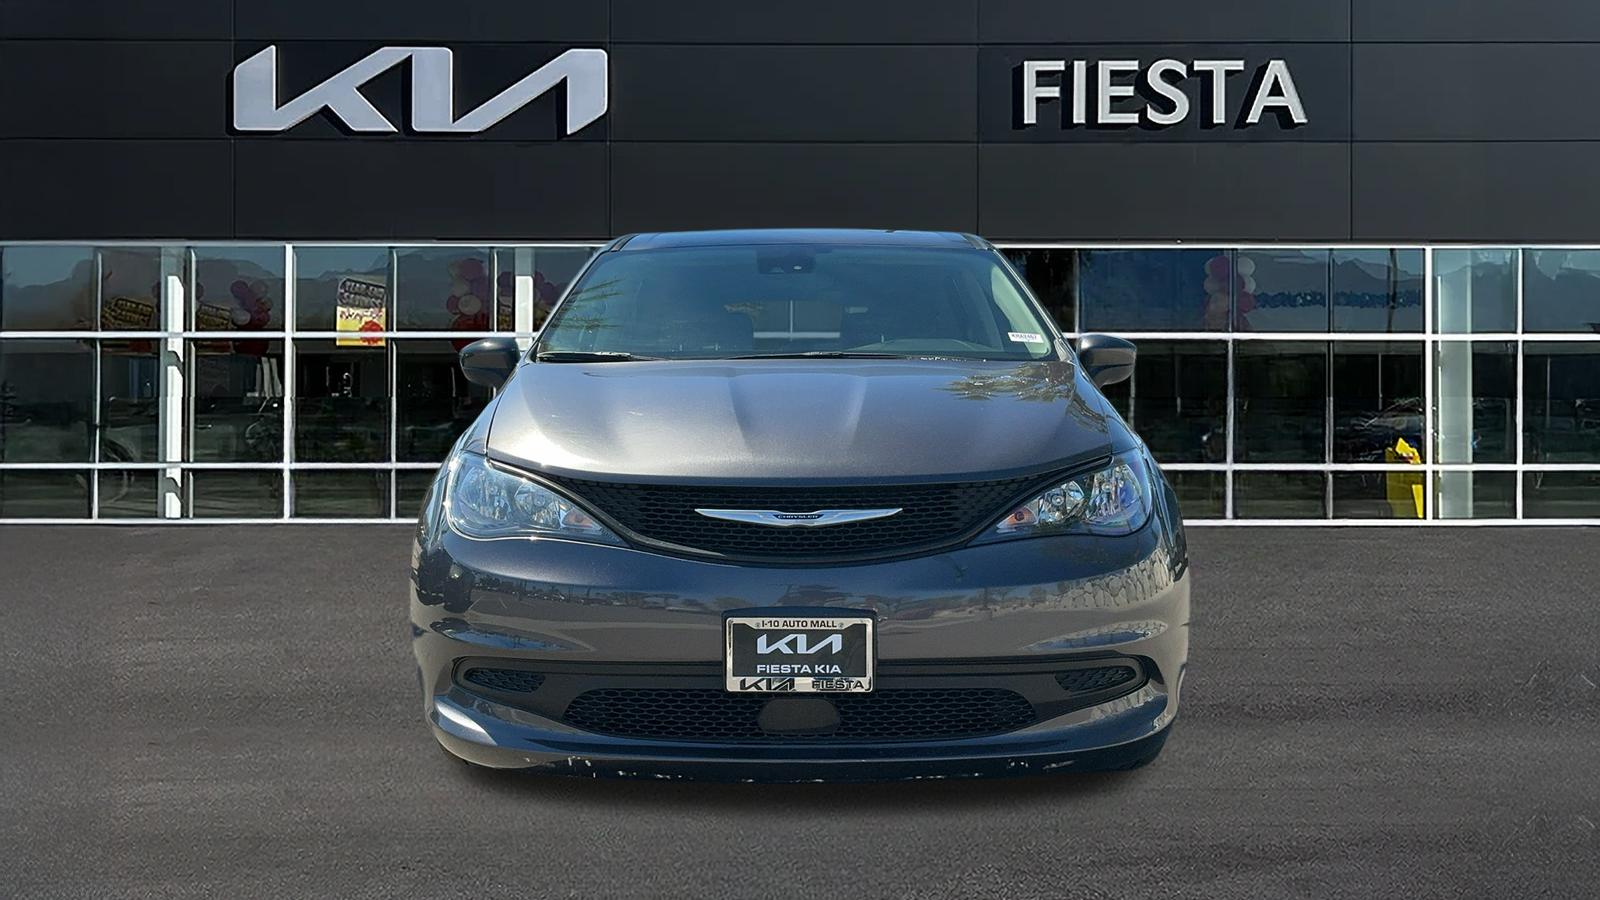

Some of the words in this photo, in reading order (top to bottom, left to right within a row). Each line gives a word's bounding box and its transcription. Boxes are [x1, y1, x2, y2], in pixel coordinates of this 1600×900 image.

[233, 44, 609, 135] KIA
[1023, 59, 1308, 125] FIESTA
[762, 620, 779, 628] I-10
[782, 620, 808, 628] AUTO
[810, 620, 837, 628] MALL
[757, 633, 843, 655] KIA
[756, 664, 812, 674] FIESTA
[815, 664, 842, 674] KIA
[739, 678, 795, 691] KIA
[812, 680, 865, 690] FIESTA
